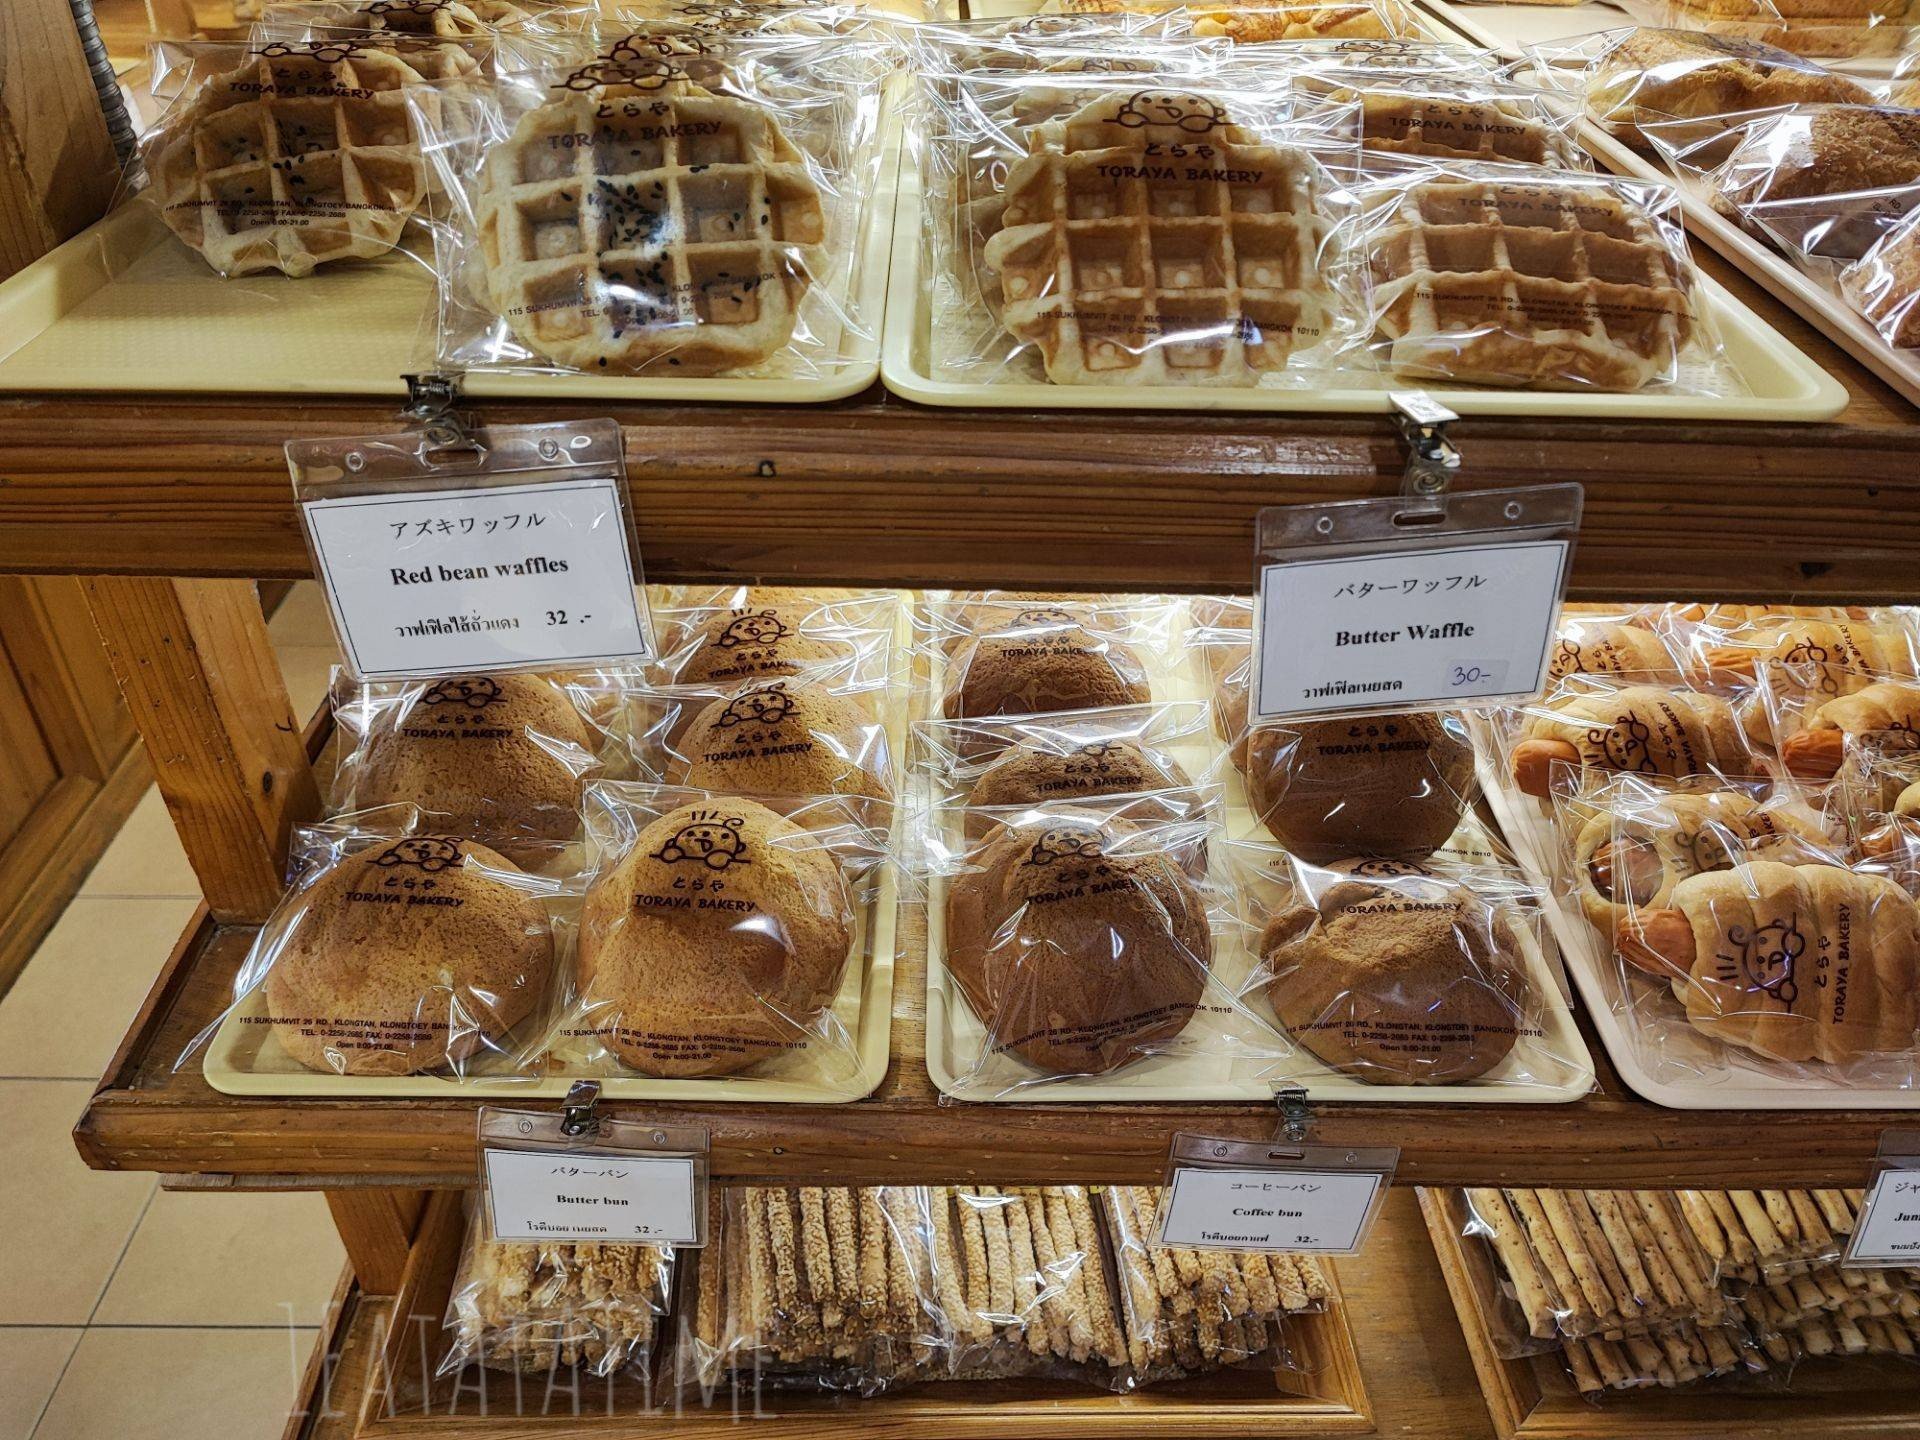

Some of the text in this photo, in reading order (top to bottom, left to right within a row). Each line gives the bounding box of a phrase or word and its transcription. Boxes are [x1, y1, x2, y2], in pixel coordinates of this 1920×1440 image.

[229, 82, 375, 100] TORAYA BAKERY
[596, 102, 670, 119] とらや
[642, 121, 721, 141] BAKERY
[1388, 117, 1526, 135] TORAYA BAKERY
[1145, 143, 1215, 158] とらや
[1097, 165, 1264, 183] TORAYA BAKERY
[390, 512, 546, 540] アズキワッフル
[391, 557, 569, 586] Red bean waffles
[1333, 574, 1487, 599] バターワッフル
[545, 610, 568, 627] 32
[1335, 622, 1475, 647] Butter Waffle
[735, 649, 778, 661] とらや
[1002, 648, 1048, 658] TORAYA
[708, 664, 756, 680] TORAYA
[402, 728, 513, 738] TORAYA BAKERY
[735, 730, 782, 744] とらや
[703, 742, 813, 763] TORAYA BAKERY
[1316, 740, 1431, 756] TORAYA BAKERY
[1036, 776, 1142, 793] TORAYA BAKERY
[384, 876, 437, 891] とらや
[672, 876, 725, 893] とらや
[344, 892, 464, 908] TORAYA BAKERY
[634, 894, 755, 913] TORAYA BAKERY
[1025, 887, 1085, 905] TORAYA
[1340, 902, 1463, 915] TORAYA BAKERY
[1814, 935, 1831, 988] とらや
[1833, 903, 1851, 1025] TORAYA BAKERY
[556, 1194, 629, 1206] Butter bun
[1232, 1208, 1303, 1217] Coffee bun
[634, 1226, 650, 1234] 32
